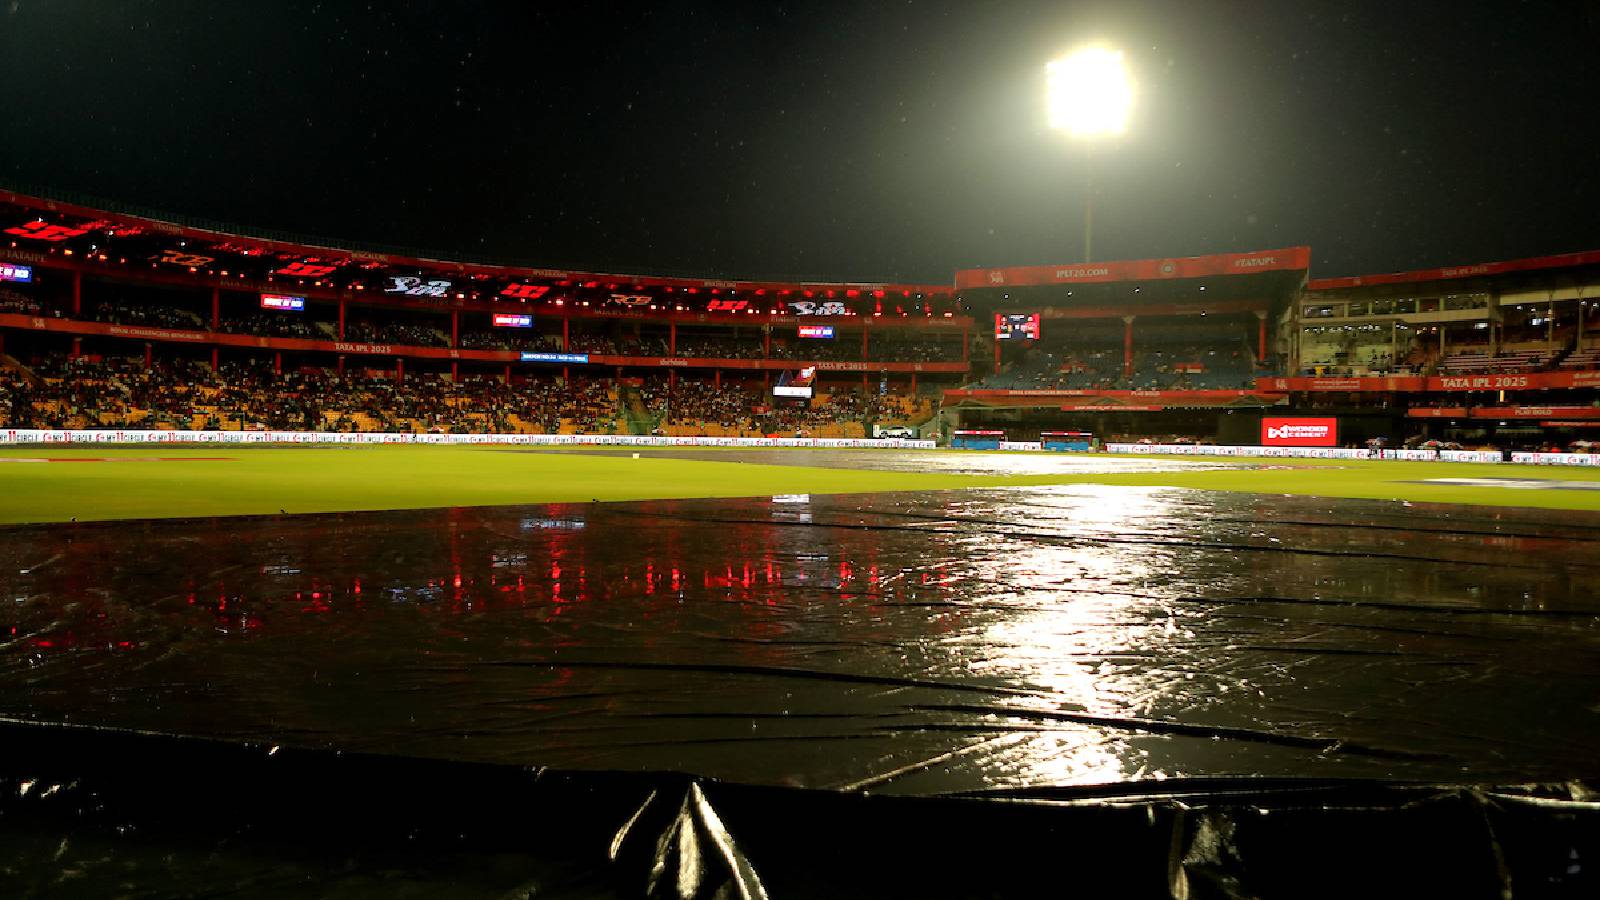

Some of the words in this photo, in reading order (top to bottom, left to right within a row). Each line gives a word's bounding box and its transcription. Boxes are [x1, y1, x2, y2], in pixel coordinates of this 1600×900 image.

[1440, 378, 1470, 388] TATA
[1472, 377, 1492, 388] IPL
[1495, 377, 1528, 387] 2025
